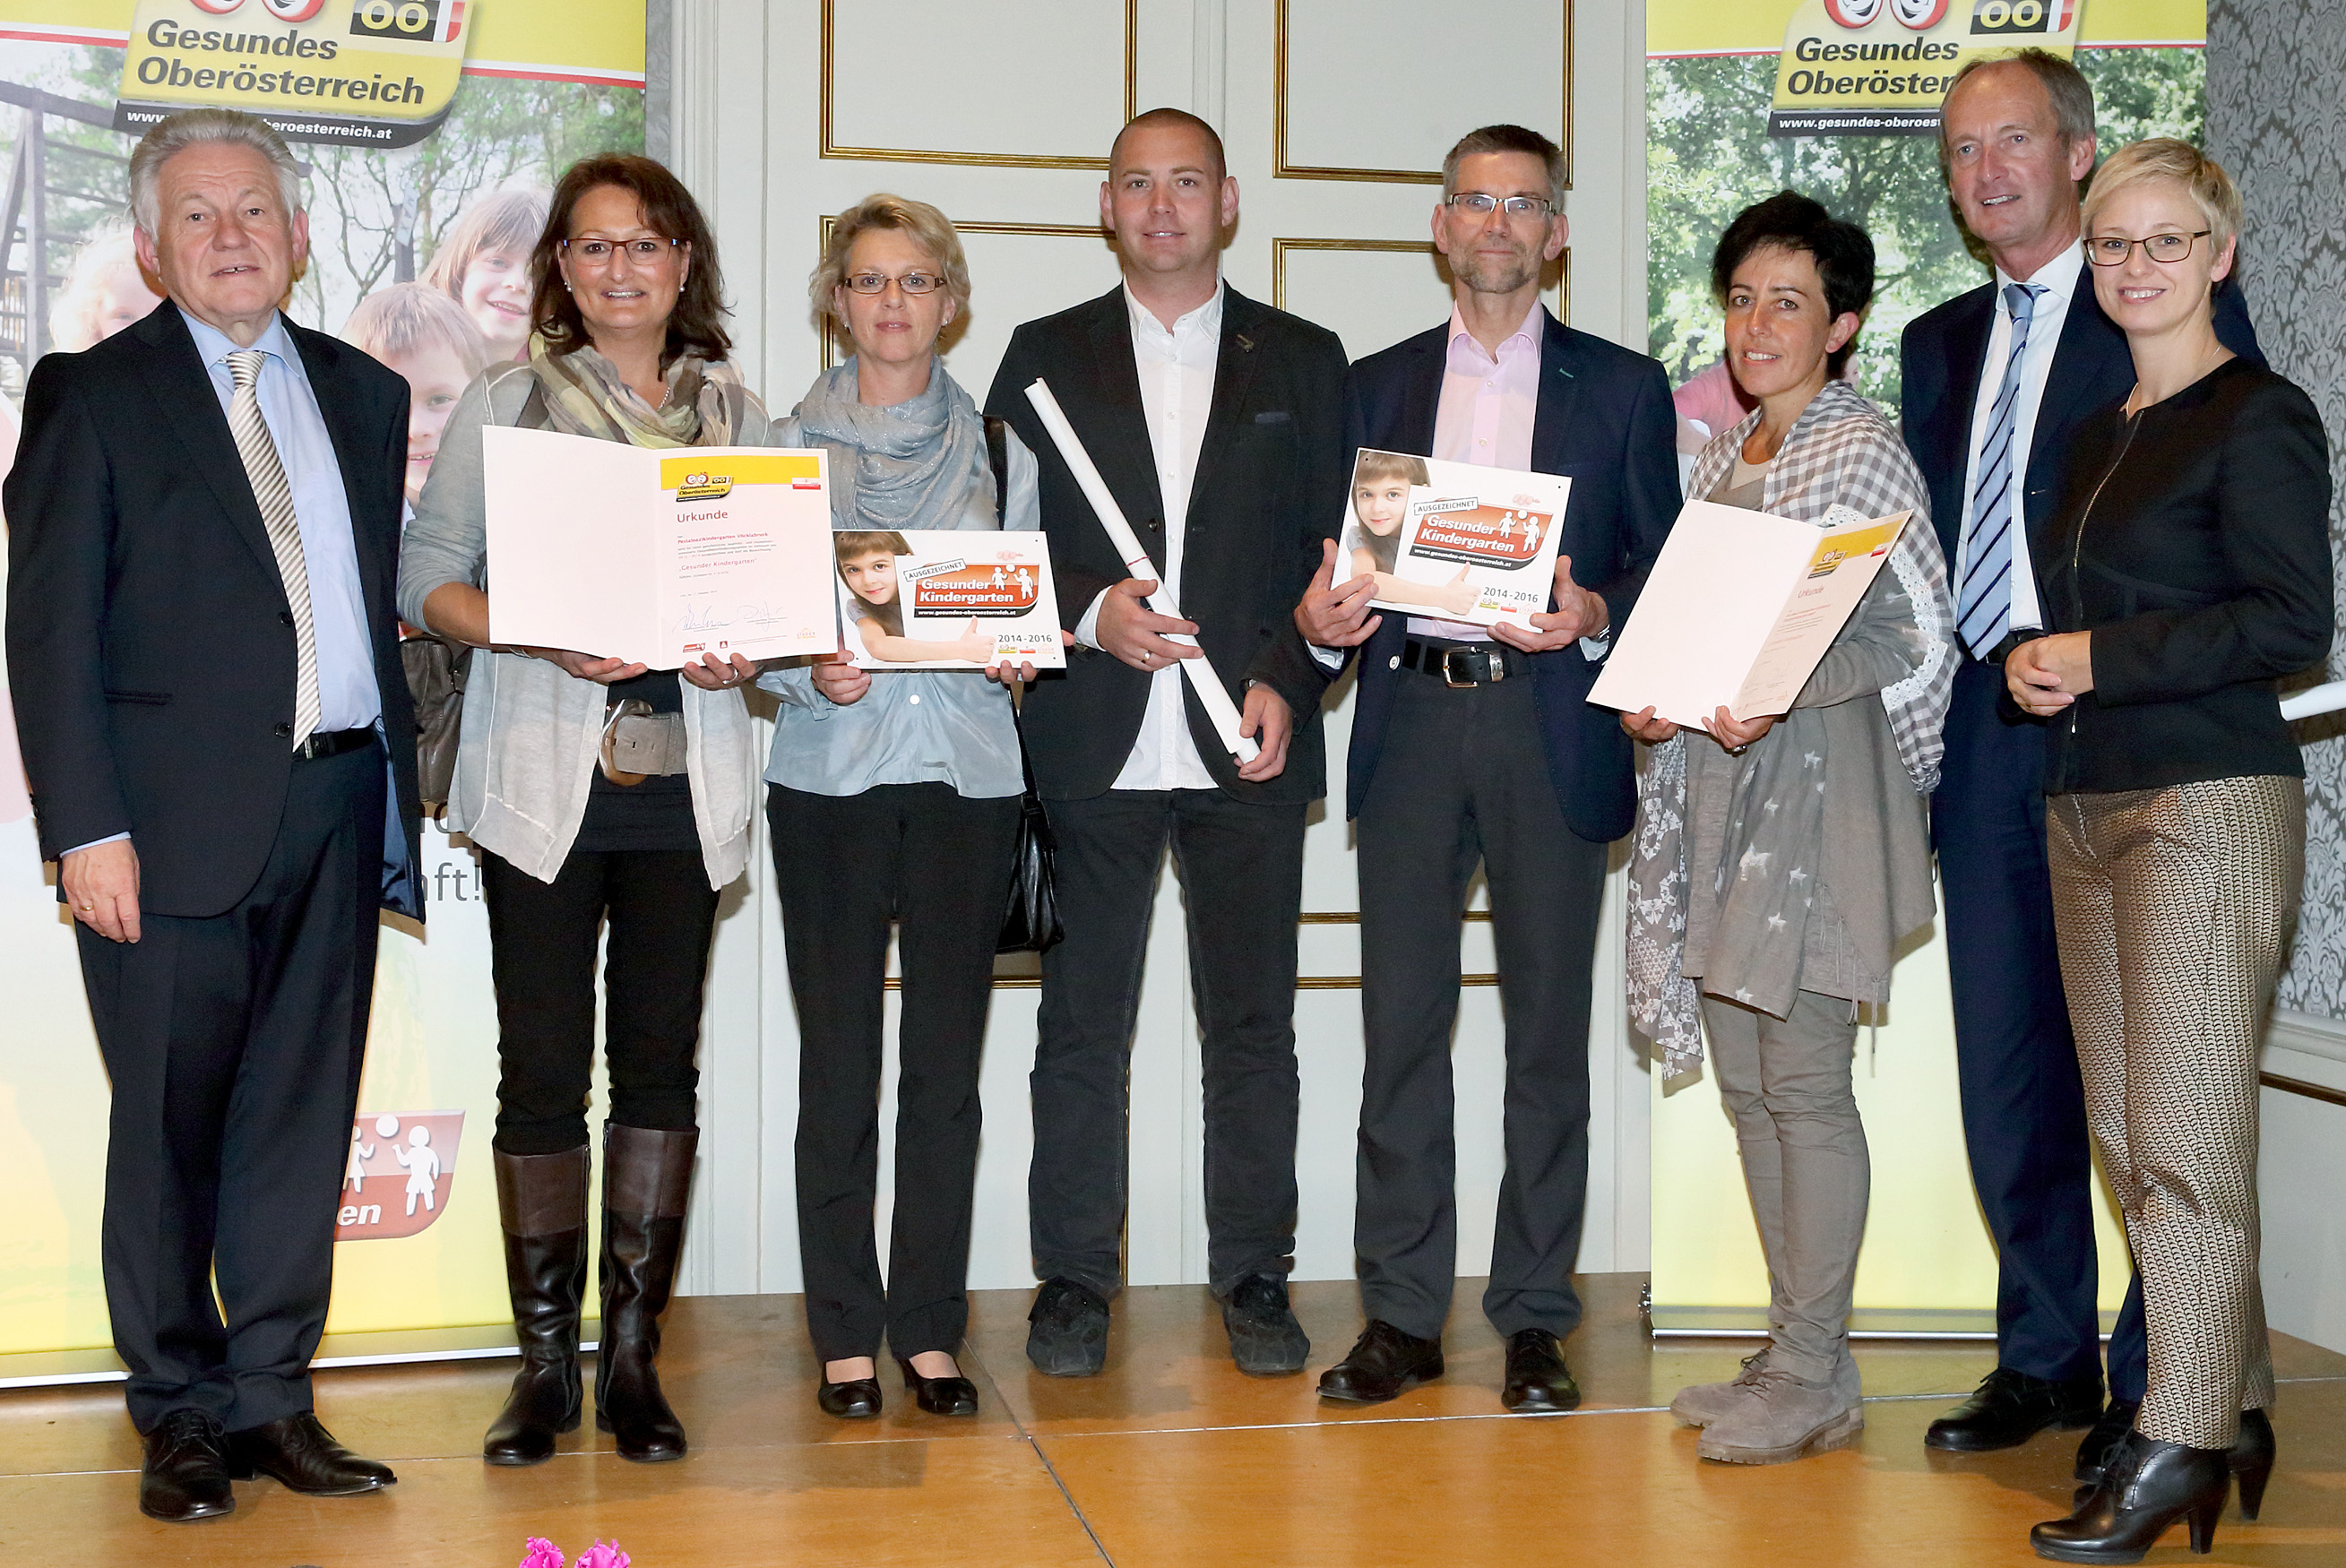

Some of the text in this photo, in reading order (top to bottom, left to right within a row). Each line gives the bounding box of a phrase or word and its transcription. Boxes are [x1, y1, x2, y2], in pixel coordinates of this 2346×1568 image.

[147, 19, 339, 60] Gesundes
[1795, 36, 1959, 62] Gesundes
[137, 56, 424, 105] Oberösterreich
[1788, 70, 1956, 94] Oberöster
[1779, 116, 1940, 130] www.gesundes-oberoes
[1418, 501, 1475, 512] AUSGEZEICHNET
[677, 510, 729, 523] Urkunde
[1427, 514, 1497, 535] Gesunder
[1420, 528, 1514, 553] Kindergarten
[909, 562, 963, 579] AUSGEZEICHNET
[921, 579, 991, 590] Gesunder
[919, 591, 1013, 605] Kindergarten
